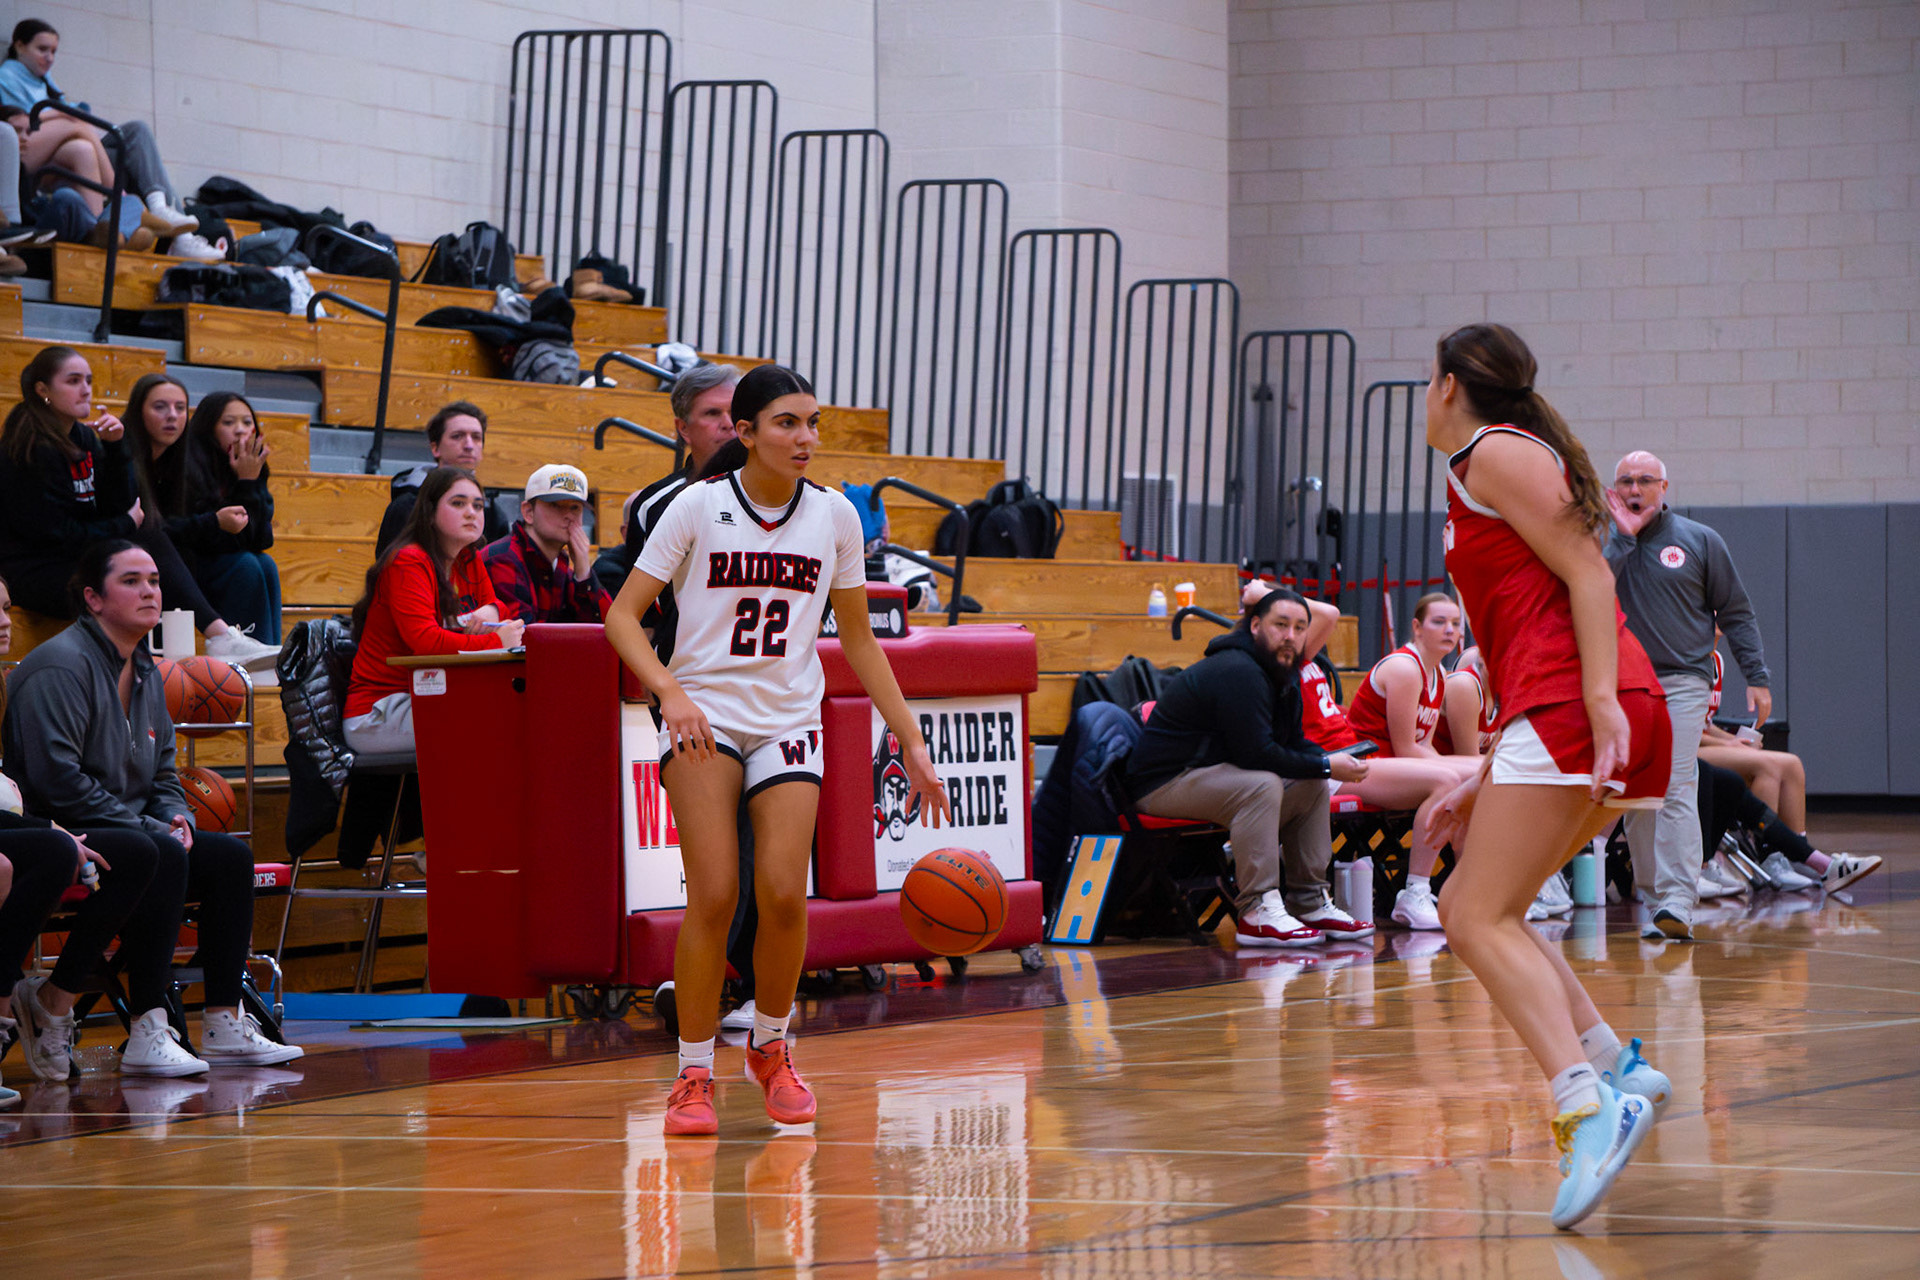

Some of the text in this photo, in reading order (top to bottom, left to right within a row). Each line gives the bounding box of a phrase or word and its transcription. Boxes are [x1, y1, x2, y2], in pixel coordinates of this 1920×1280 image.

[707, 550, 822, 595] RAIDERS
[729, 597, 790, 658] 22
[779, 738, 807, 767] W
[919, 711, 1016, 765] RAIDER
[935, 774, 1009, 828] RIDE
[254, 872, 276, 888] DERS
[935, 854, 991, 891] ELITE
